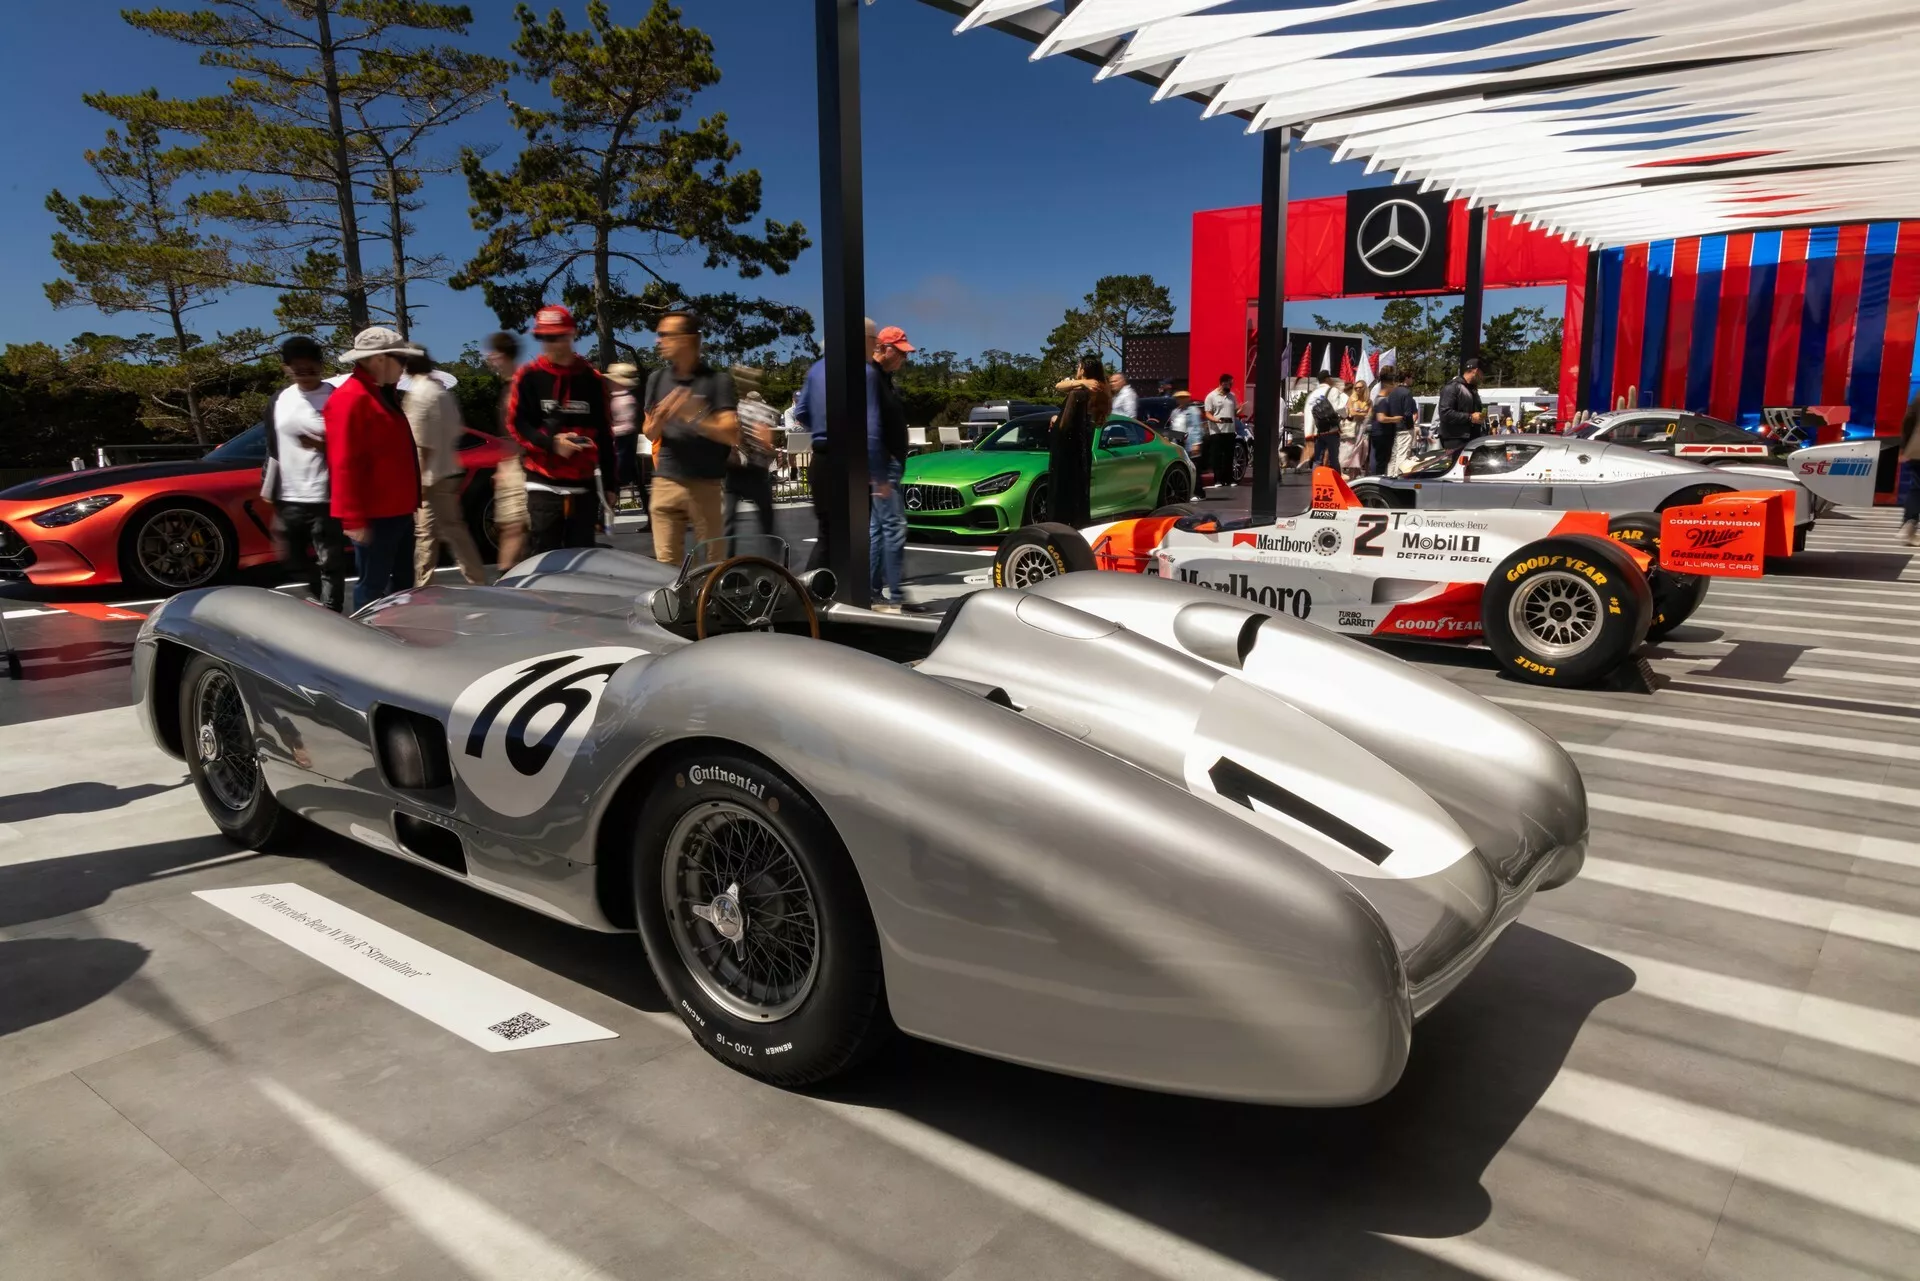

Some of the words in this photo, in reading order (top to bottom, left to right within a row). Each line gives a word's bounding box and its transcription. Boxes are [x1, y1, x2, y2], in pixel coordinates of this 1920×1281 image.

[1314, 502, 1340, 510] BOSCH
[1391, 512, 1407, 530] T
[1425, 519, 1488, 530] Mercedes-Benz
[1257, 534, 1312, 553] Marlboro
[1353, 514, 1389, 557] 2
[1402, 532, 1458, 551] Mobil
[1686, 528, 1744, 548] Miller
[1396, 552, 1445, 561] DETROIT
[1450, 555, 1492, 563] DIESEL
[1671, 550, 1719, 560] Genuine
[1722, 552, 1755, 561] Draft
[1674, 560, 1726, 568] WILLIAMS
[1338, 617, 1375, 627] GARRETT
[1515, 656, 1555, 676] EAGLE
[464, 655, 625, 776] 16
[689, 765, 765, 799] Continental
[1208, 756, 1394, 866] 1
[251, 892, 279, 907] 1955
[272, 900, 331, 933] Mercedes-Benz
[335, 933, 358, 946] 196
[353, 941, 367, 951] R
[682, 1000, 706, 1027] RACING
[765, 1042, 793, 1055] RENNER
